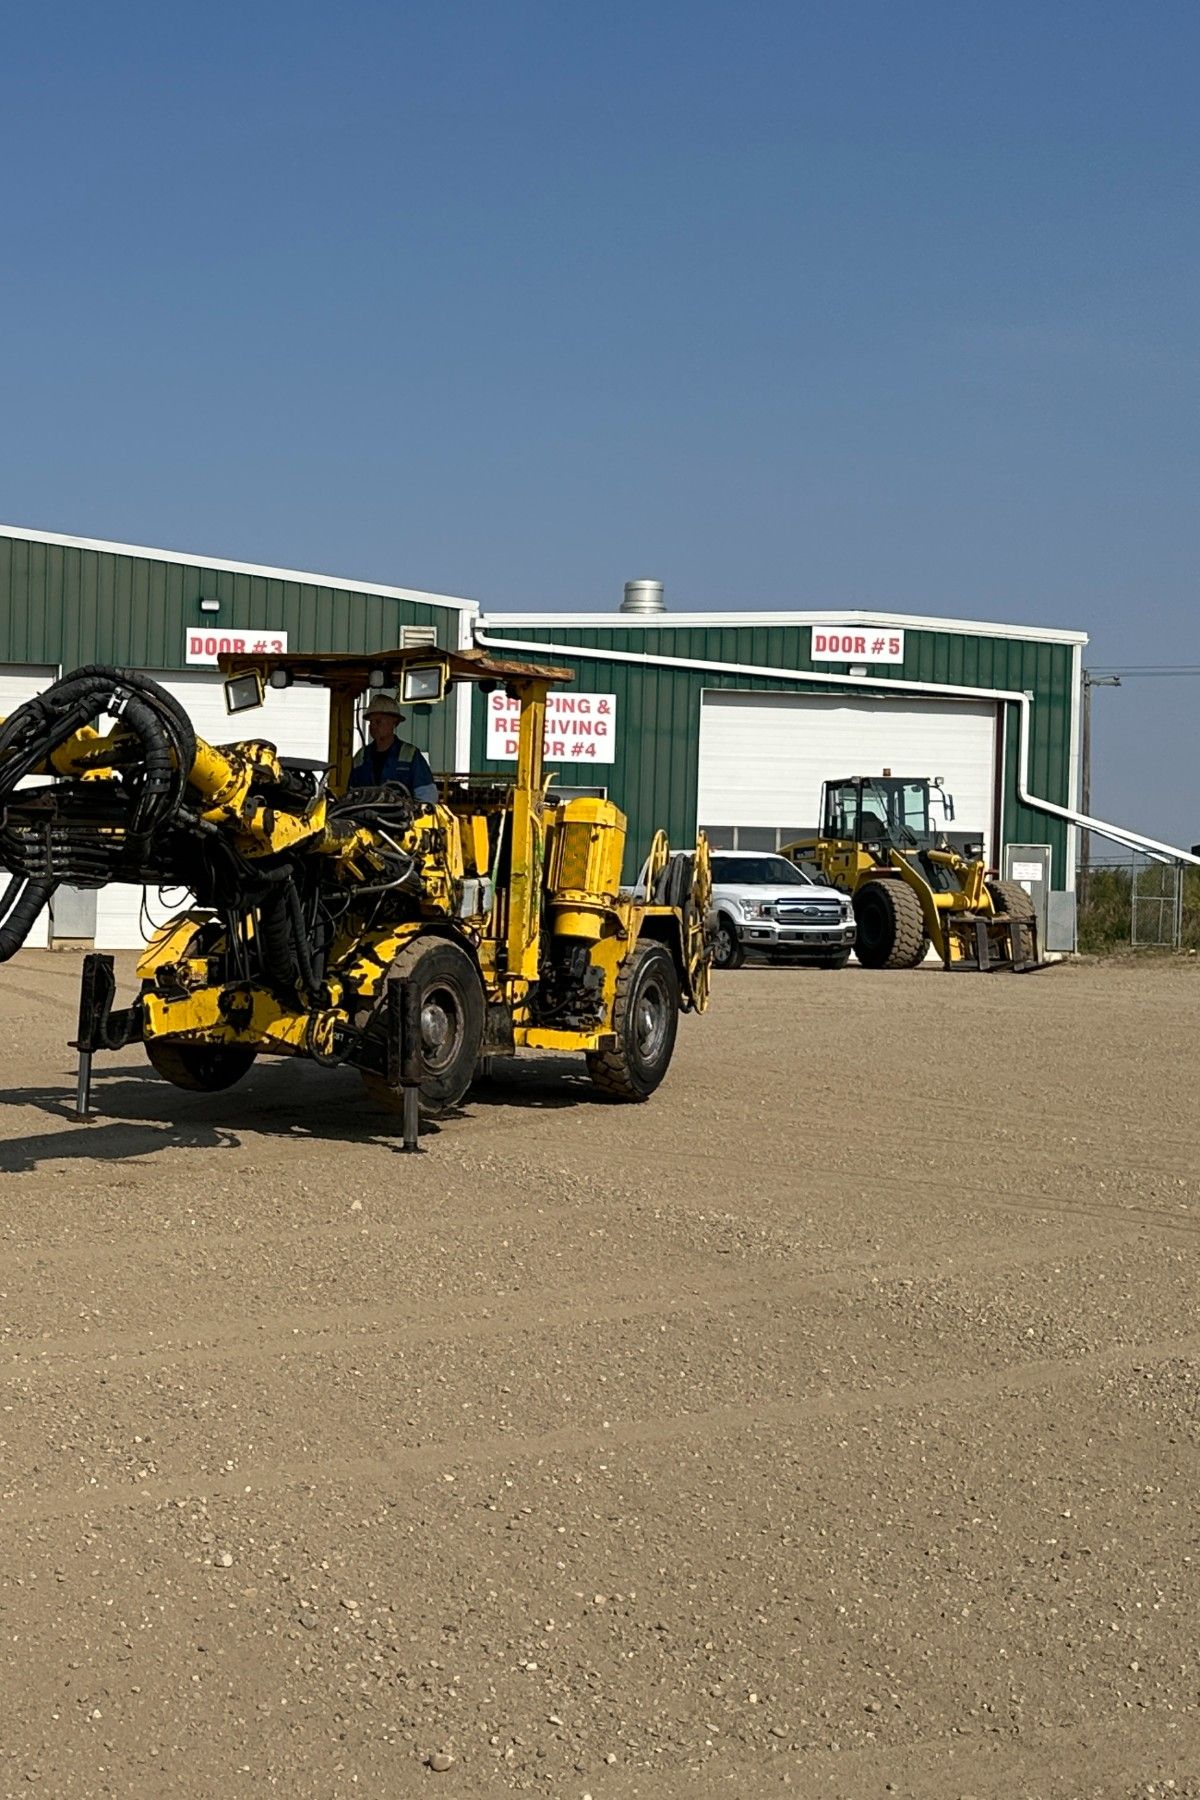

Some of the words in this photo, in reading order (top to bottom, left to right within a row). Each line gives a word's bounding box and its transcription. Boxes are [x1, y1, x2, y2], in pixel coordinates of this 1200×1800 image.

[190, 637, 245, 655] DOOR
[815, 635, 865, 653] DOOR
[871, 637, 900, 654] #5
[492, 696, 591, 713] SHPING
[597, 699, 611, 714] &
[495, 718, 608, 735] REIVING
[505, 740, 565, 756] DOR
[571, 742, 596, 757] #4
